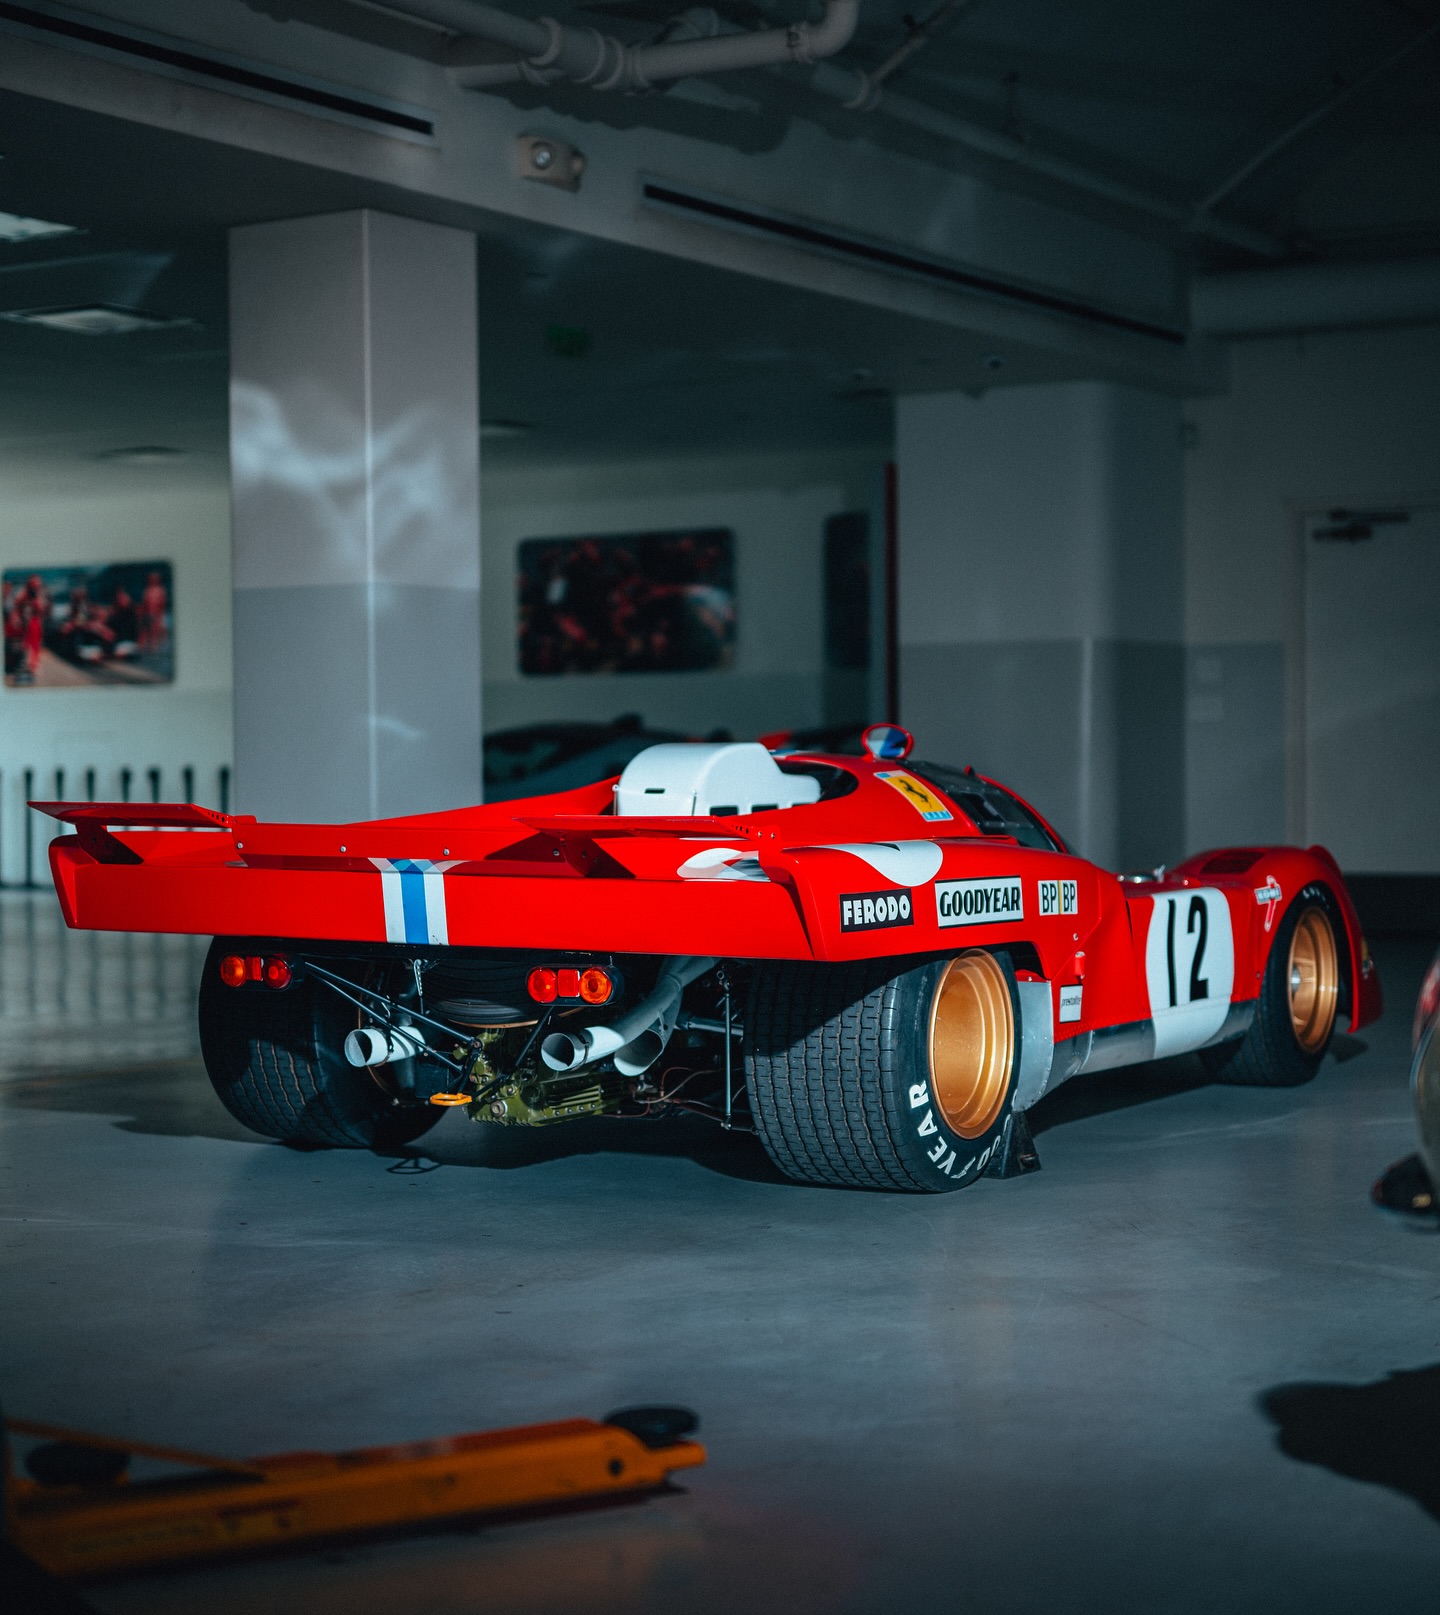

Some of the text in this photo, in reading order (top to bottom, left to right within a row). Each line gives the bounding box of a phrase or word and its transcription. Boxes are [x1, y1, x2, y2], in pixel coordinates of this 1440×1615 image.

[843, 894, 911, 926] FERODO
[939, 886, 1021, 917] GOODYEAR
[1041, 882, 1076, 913] BP BP
[1167, 894, 1209, 1007] 12
